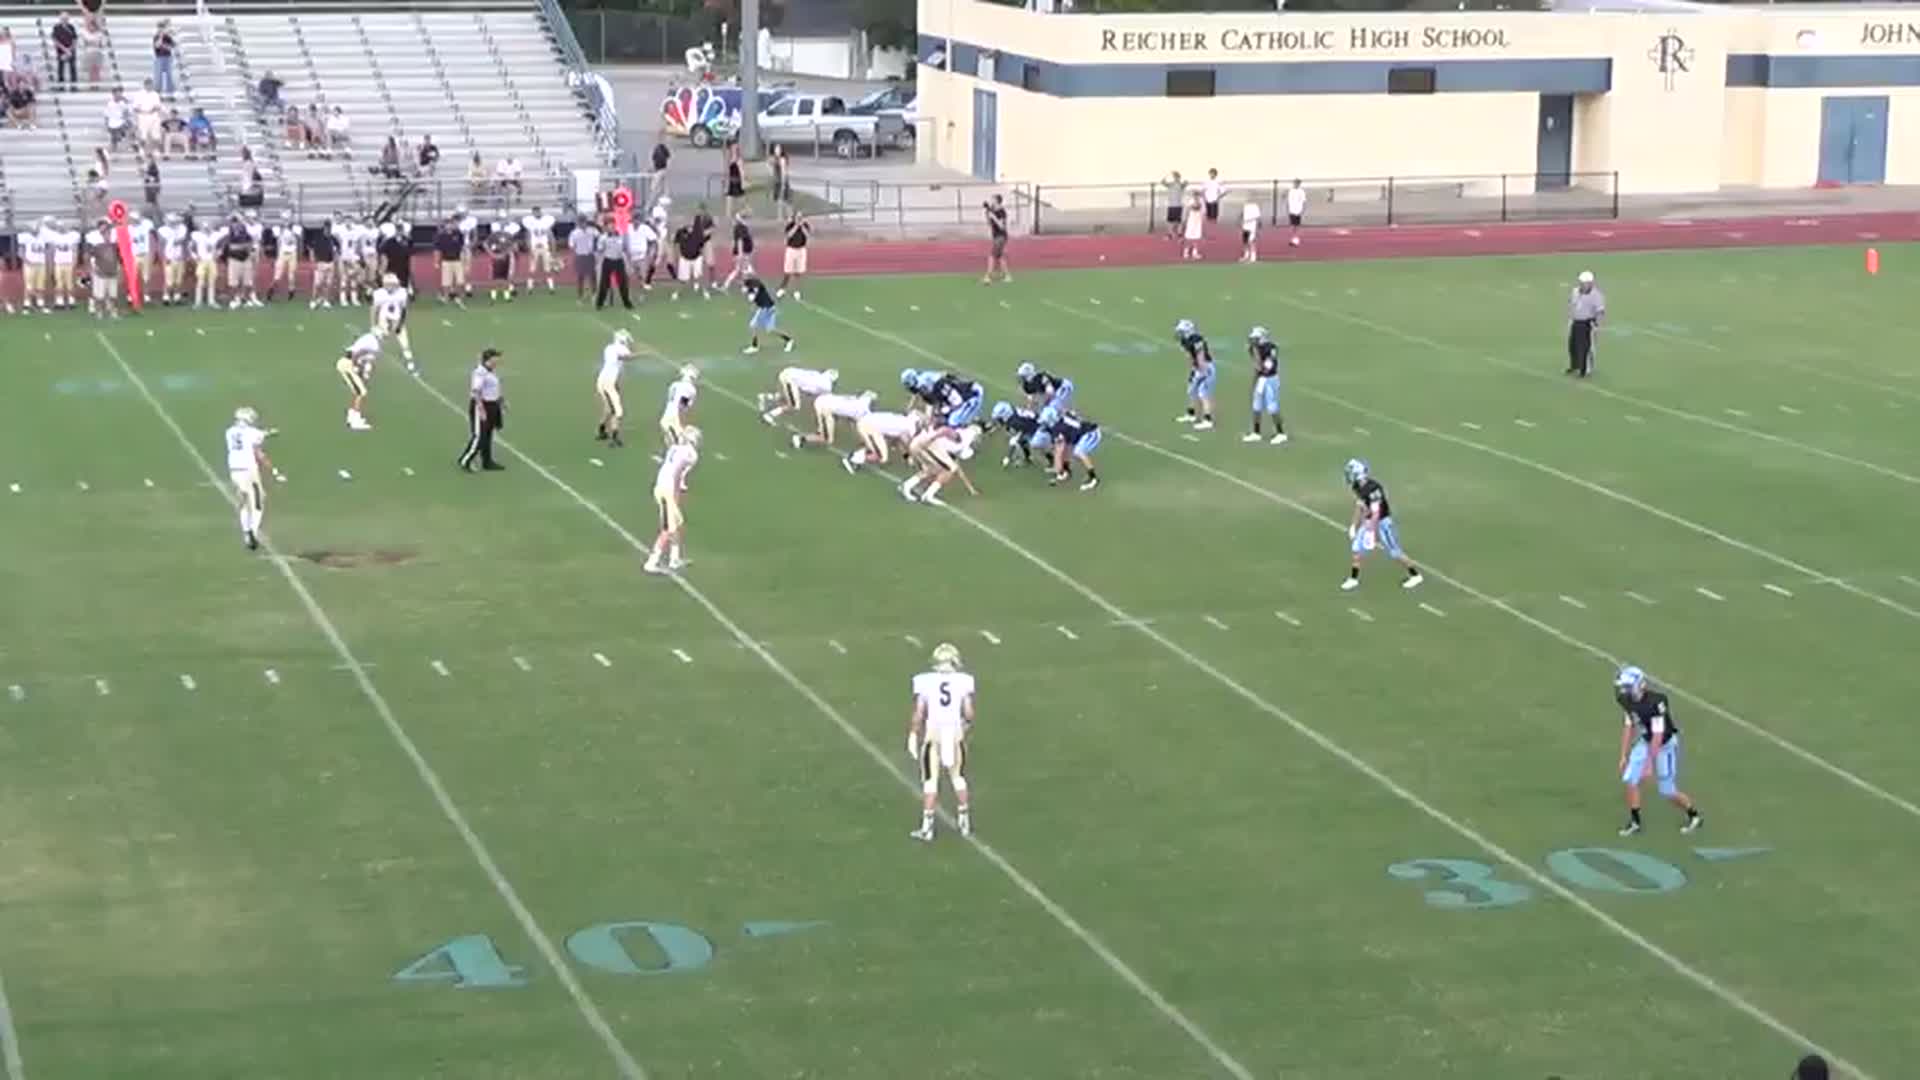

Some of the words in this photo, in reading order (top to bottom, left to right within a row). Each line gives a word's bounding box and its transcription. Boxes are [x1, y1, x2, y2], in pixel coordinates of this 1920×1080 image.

[1101, 29, 1207, 51] REICHER
[1222, 28, 1335, 50] CATHOLIC
[1350, 27, 1410, 49] HIGH
[1423, 26, 1510, 49] SCHOOL
